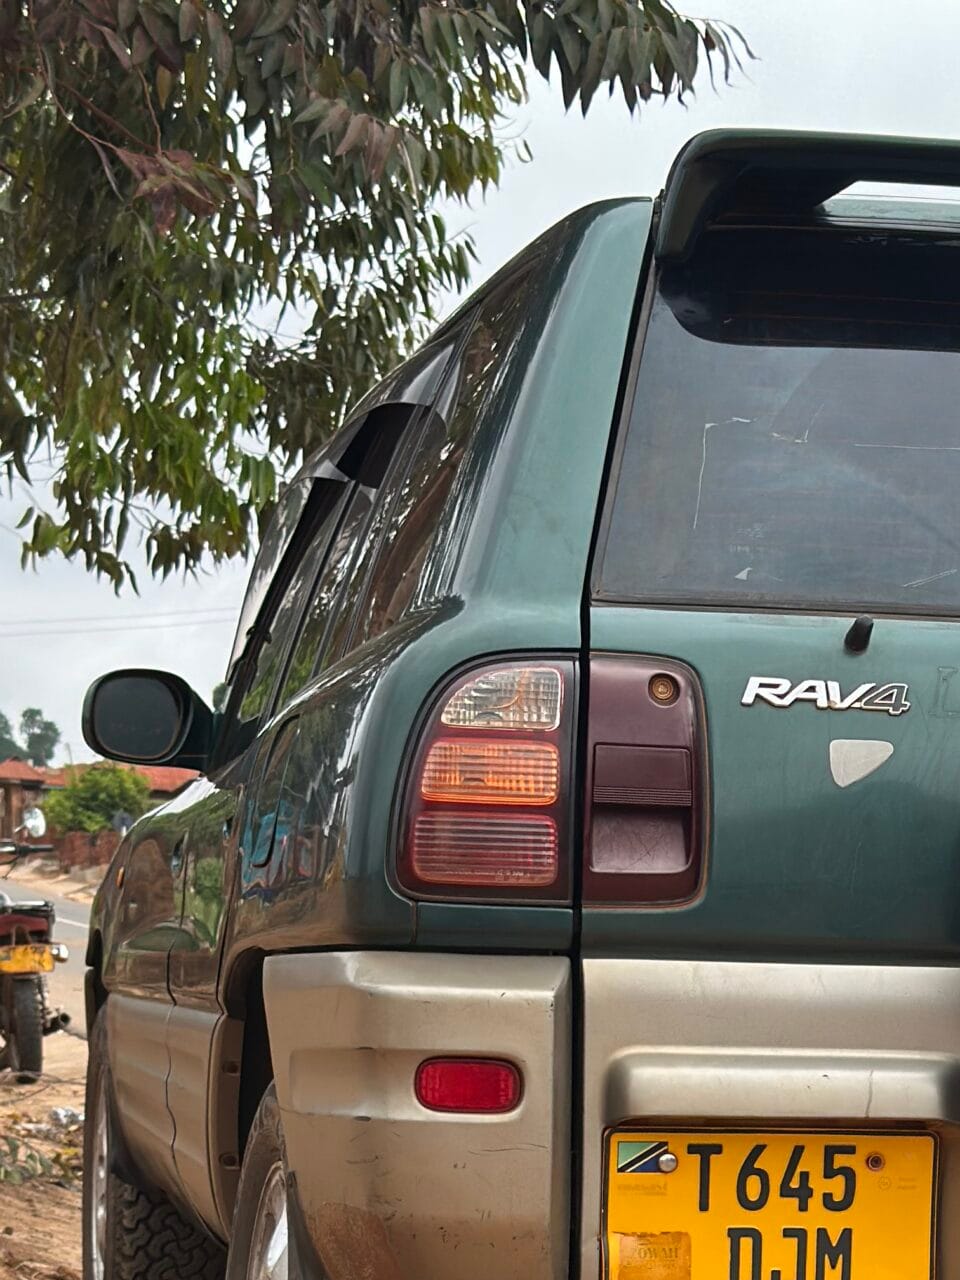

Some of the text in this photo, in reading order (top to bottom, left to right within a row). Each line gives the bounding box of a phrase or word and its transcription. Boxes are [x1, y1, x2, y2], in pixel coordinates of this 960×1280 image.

[741, 676, 912, 716] RAV4
[687, 1144, 857, 1212] T 645
